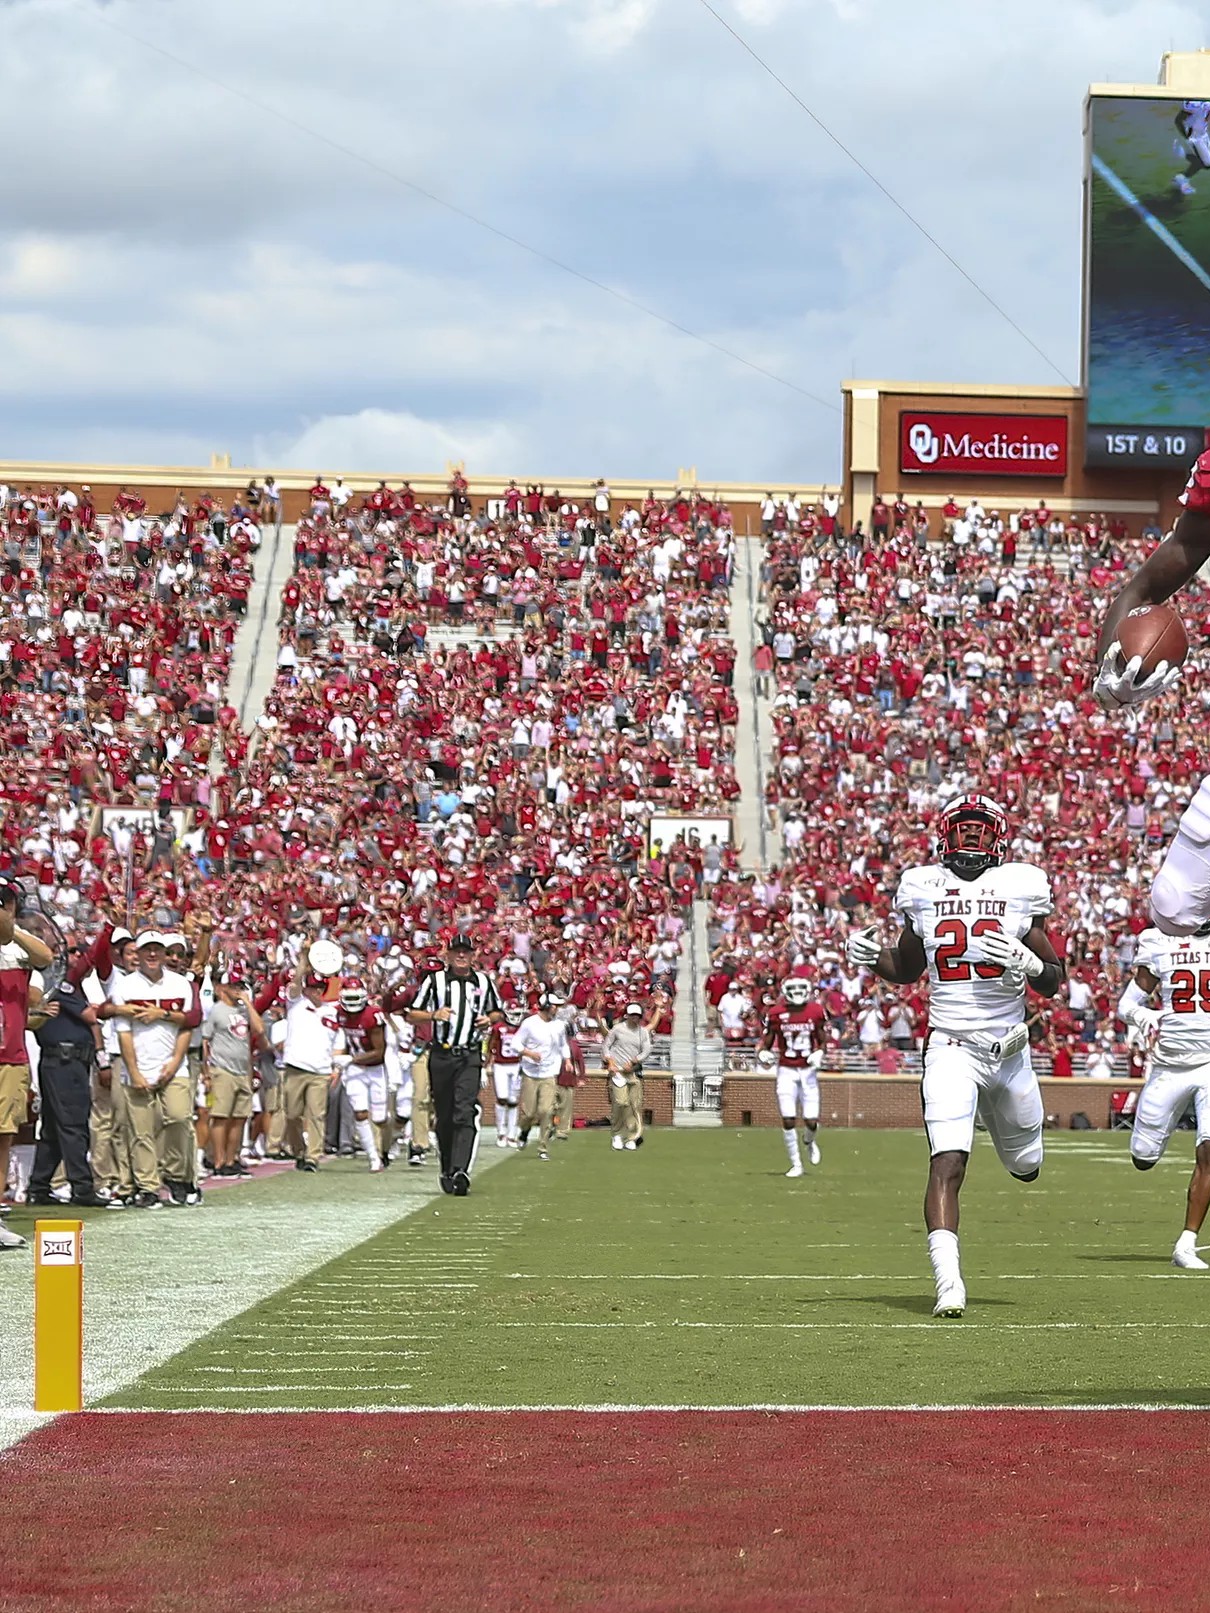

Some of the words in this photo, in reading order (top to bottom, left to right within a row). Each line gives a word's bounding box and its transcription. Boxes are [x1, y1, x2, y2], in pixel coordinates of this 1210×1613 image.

[909, 423, 939, 464] OU
[943, 433, 1060, 461] Medicine
[1106, 434, 1139, 454] 1ST
[1143, 435, 1159, 455] &
[1164, 436, 1186, 455] 10
[933, 899, 972, 918] TEXAS
[976, 900, 1008, 917] TECH
[1170, 951, 1201, 966] TEXAS
